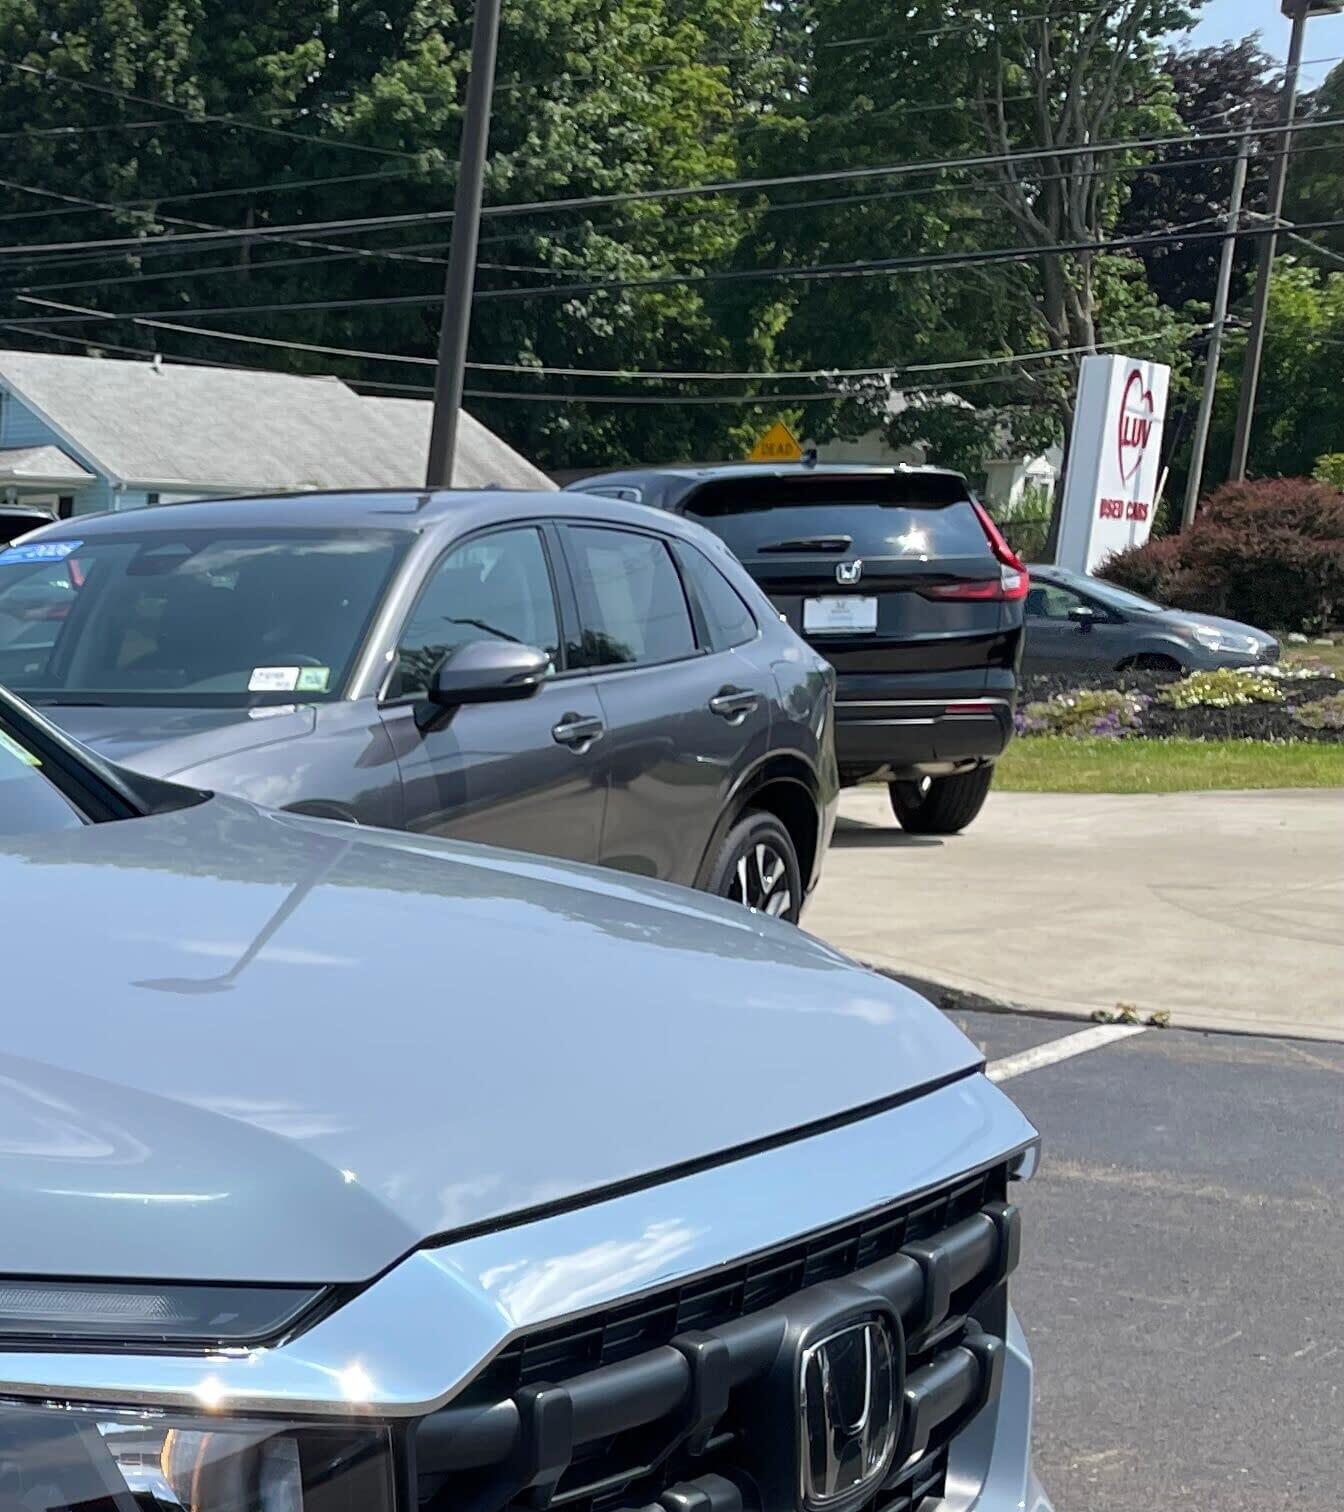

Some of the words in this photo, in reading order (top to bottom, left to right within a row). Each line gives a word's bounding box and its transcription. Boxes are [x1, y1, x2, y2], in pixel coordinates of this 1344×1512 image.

[1120, 415, 1152, 449] LUV
[1099, 499, 1124, 519] USED
[1126, 501, 1149, 522] CARS
